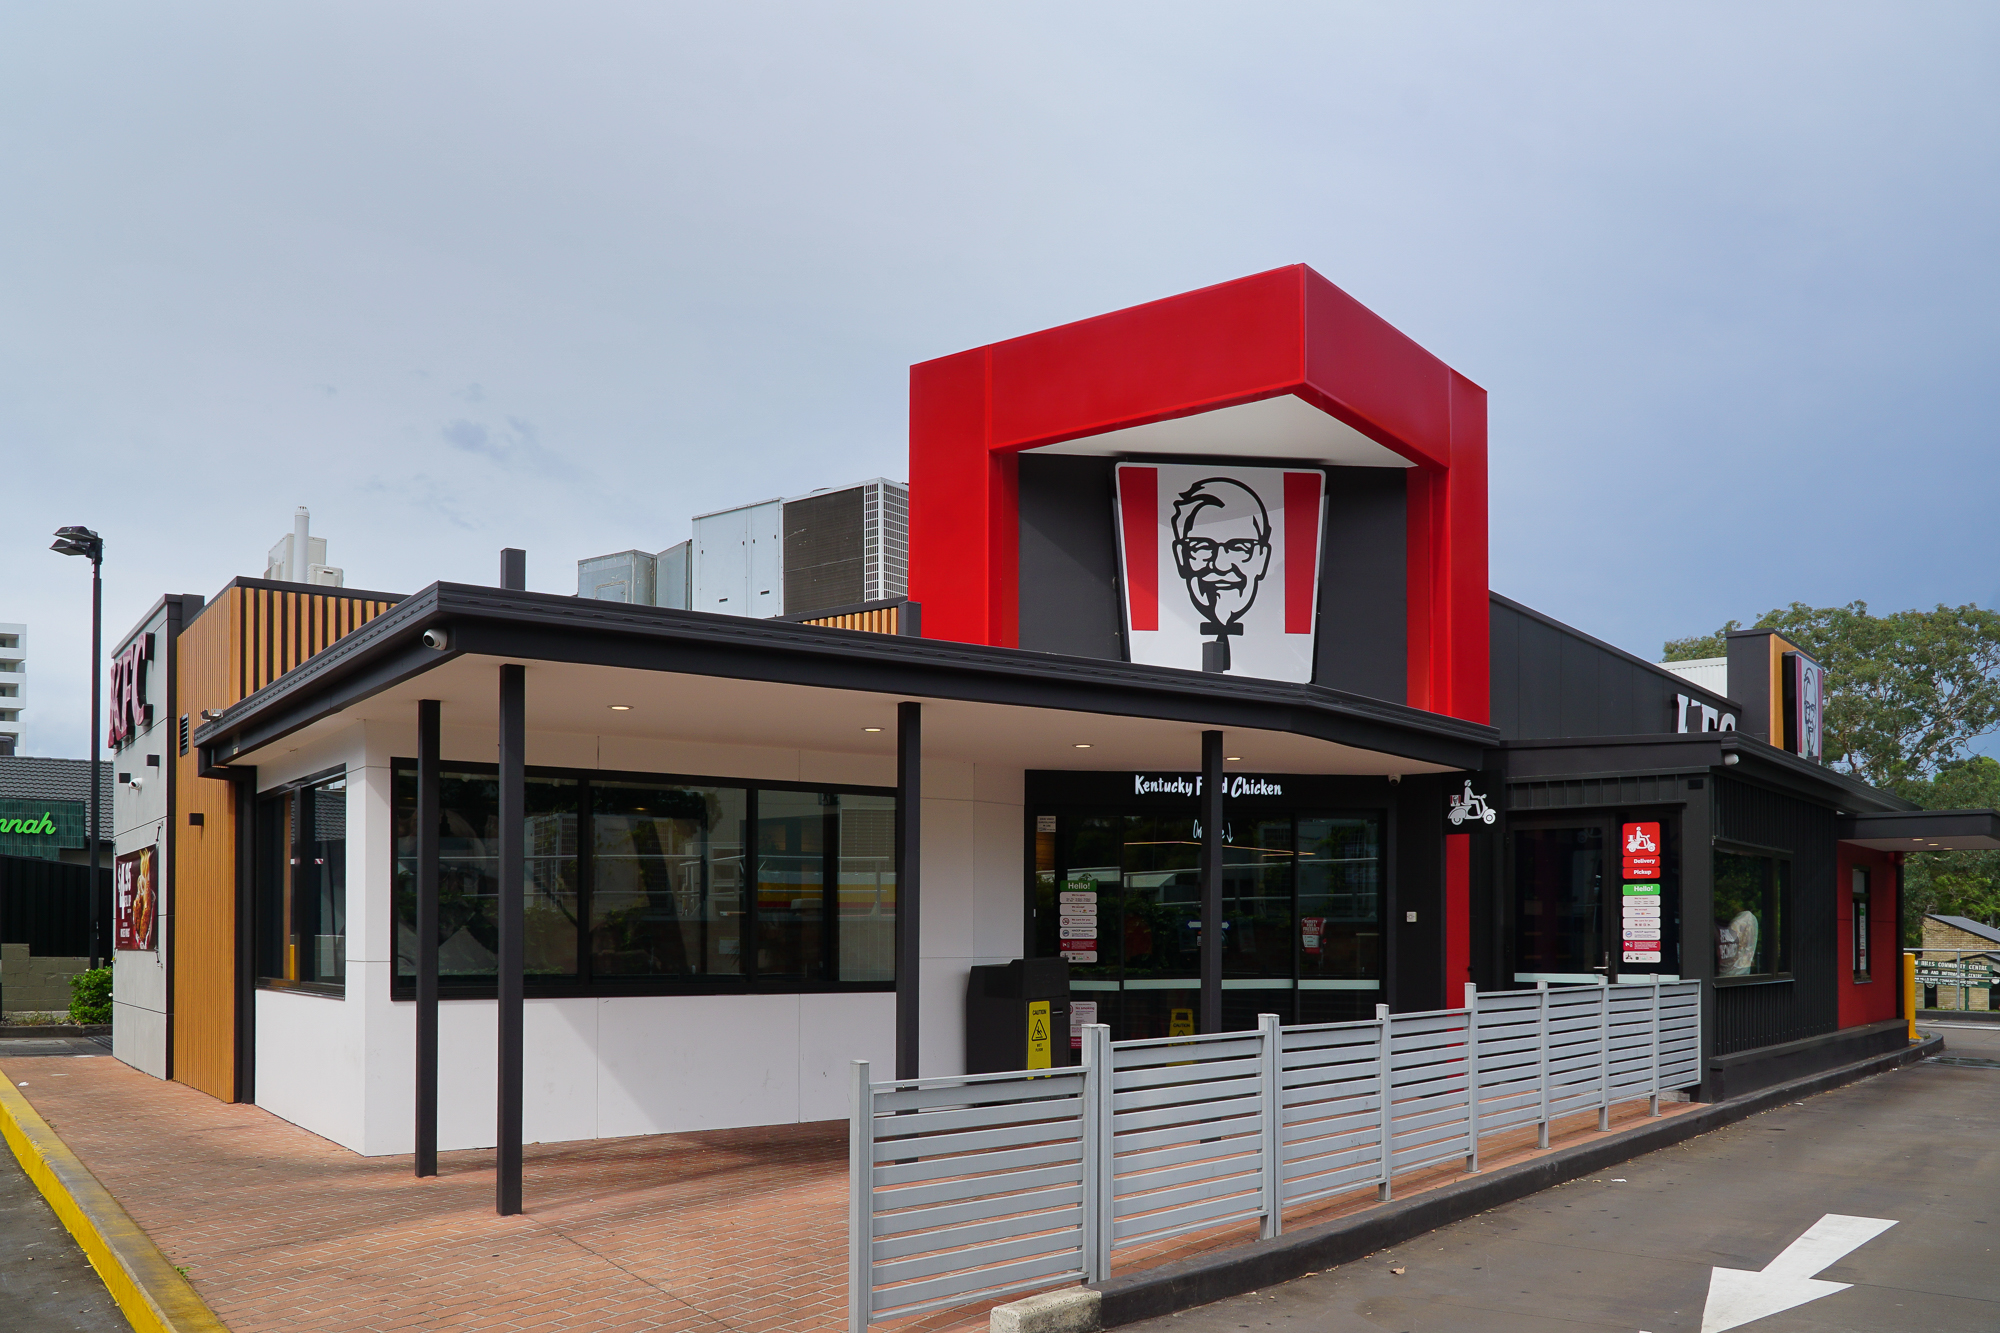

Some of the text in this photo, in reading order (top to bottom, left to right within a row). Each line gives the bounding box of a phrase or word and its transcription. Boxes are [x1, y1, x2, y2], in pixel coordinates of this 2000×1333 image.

[108, 631, 155, 749] KFC
[1134, 774, 1193, 797] Kentucky
[1230, 776, 1283, 799] Chicken
